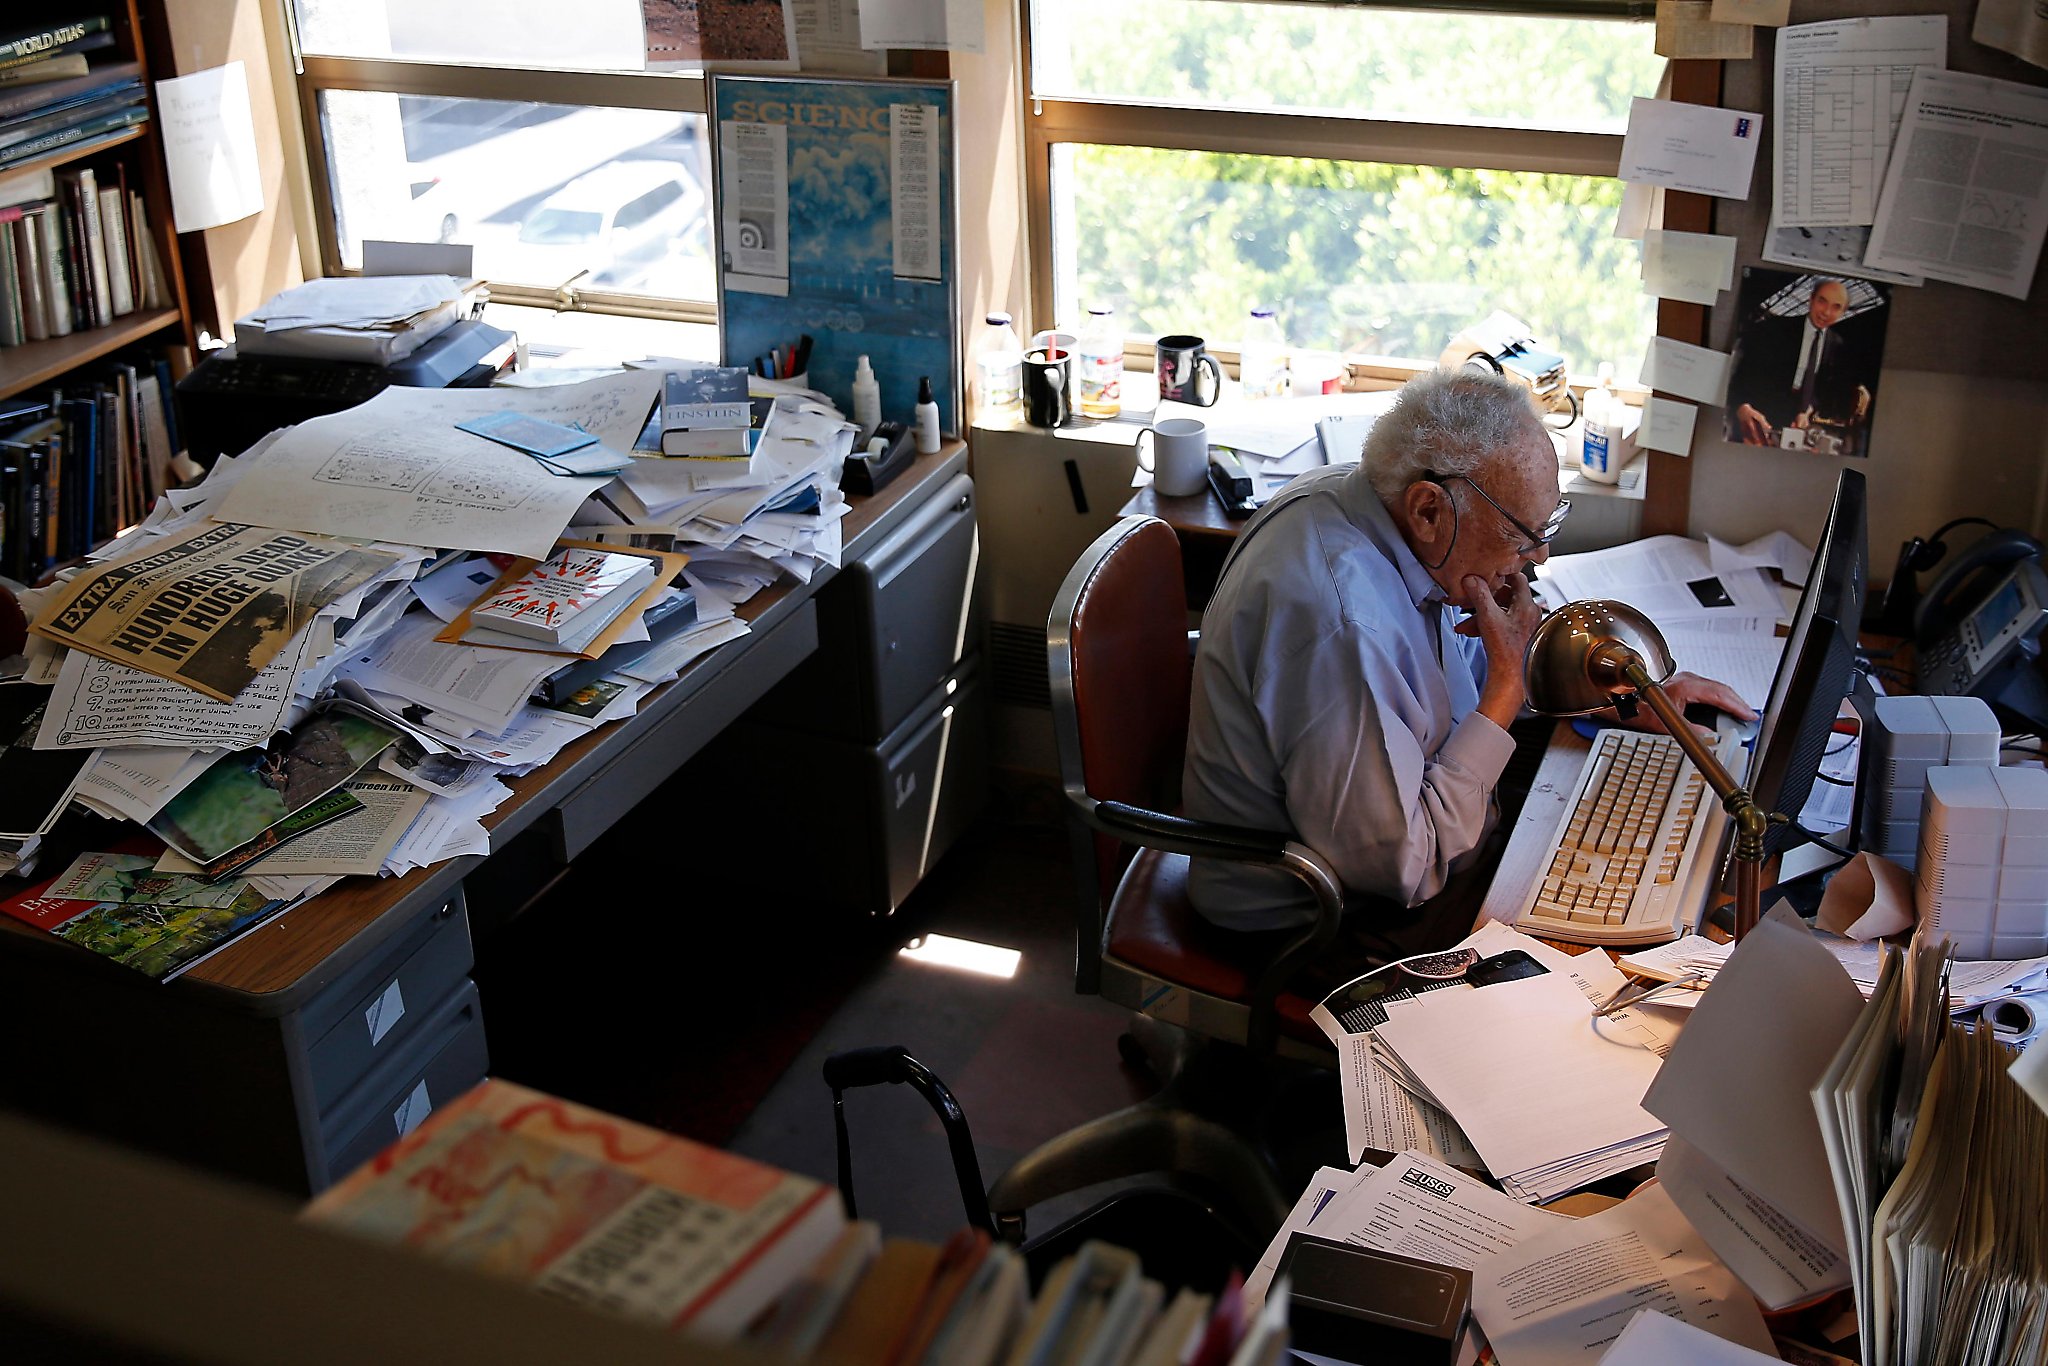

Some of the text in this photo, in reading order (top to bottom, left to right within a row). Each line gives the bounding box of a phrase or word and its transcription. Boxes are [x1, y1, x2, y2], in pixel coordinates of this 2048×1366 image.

[12, 32, 54, 56] WORLD
[54, 23, 86, 46] ATLAS
[666, 408, 742, 420] EINSTEIN
[60, 524, 248, 628] EXTRA EXTRA EXTRA
[108, 540, 242, 614] San Francisco Chronicle
[110, 536, 308, 656] HUNDREDS DEAD
[150, 546, 335, 662] IN HUGE QUAKE
[492, 599, 527, 610] KEVIN
[88, 676, 110, 693] 8
[157, 686, 190, 695] SECTION,
[354, 782, 389, 791] green
[388, 783, 401, 792] in
[316, 796, 351, 812] This
[55, 855, 104, 896] Butterflies
[1610, 1011, 1630, 1024] Wind
[1418, 1174, 1453, 1194] USGS
[1392, 1194, 1407, 1204] Policy
[1416, 1204, 1432, 1213] Rapid
[1432, 1210, 1463, 1226] Mobilization
[1470, 1227, 1484, 1236] USGS
[1428, 1192, 1448, 1202] Coastal
[1459, 1205, 1476, 1214] Marine
[1477, 1212, 1496, 1223] Science
[1497, 1221, 1516, 1231] Center
[1414, 1224, 1431, 1233] Written
[1438, 1234, 1451, 1242] David
[1451, 1240, 1481, 1255] Oppenheimer
[1419, 1218, 1480, 1248] Mendocino Triple Junction
